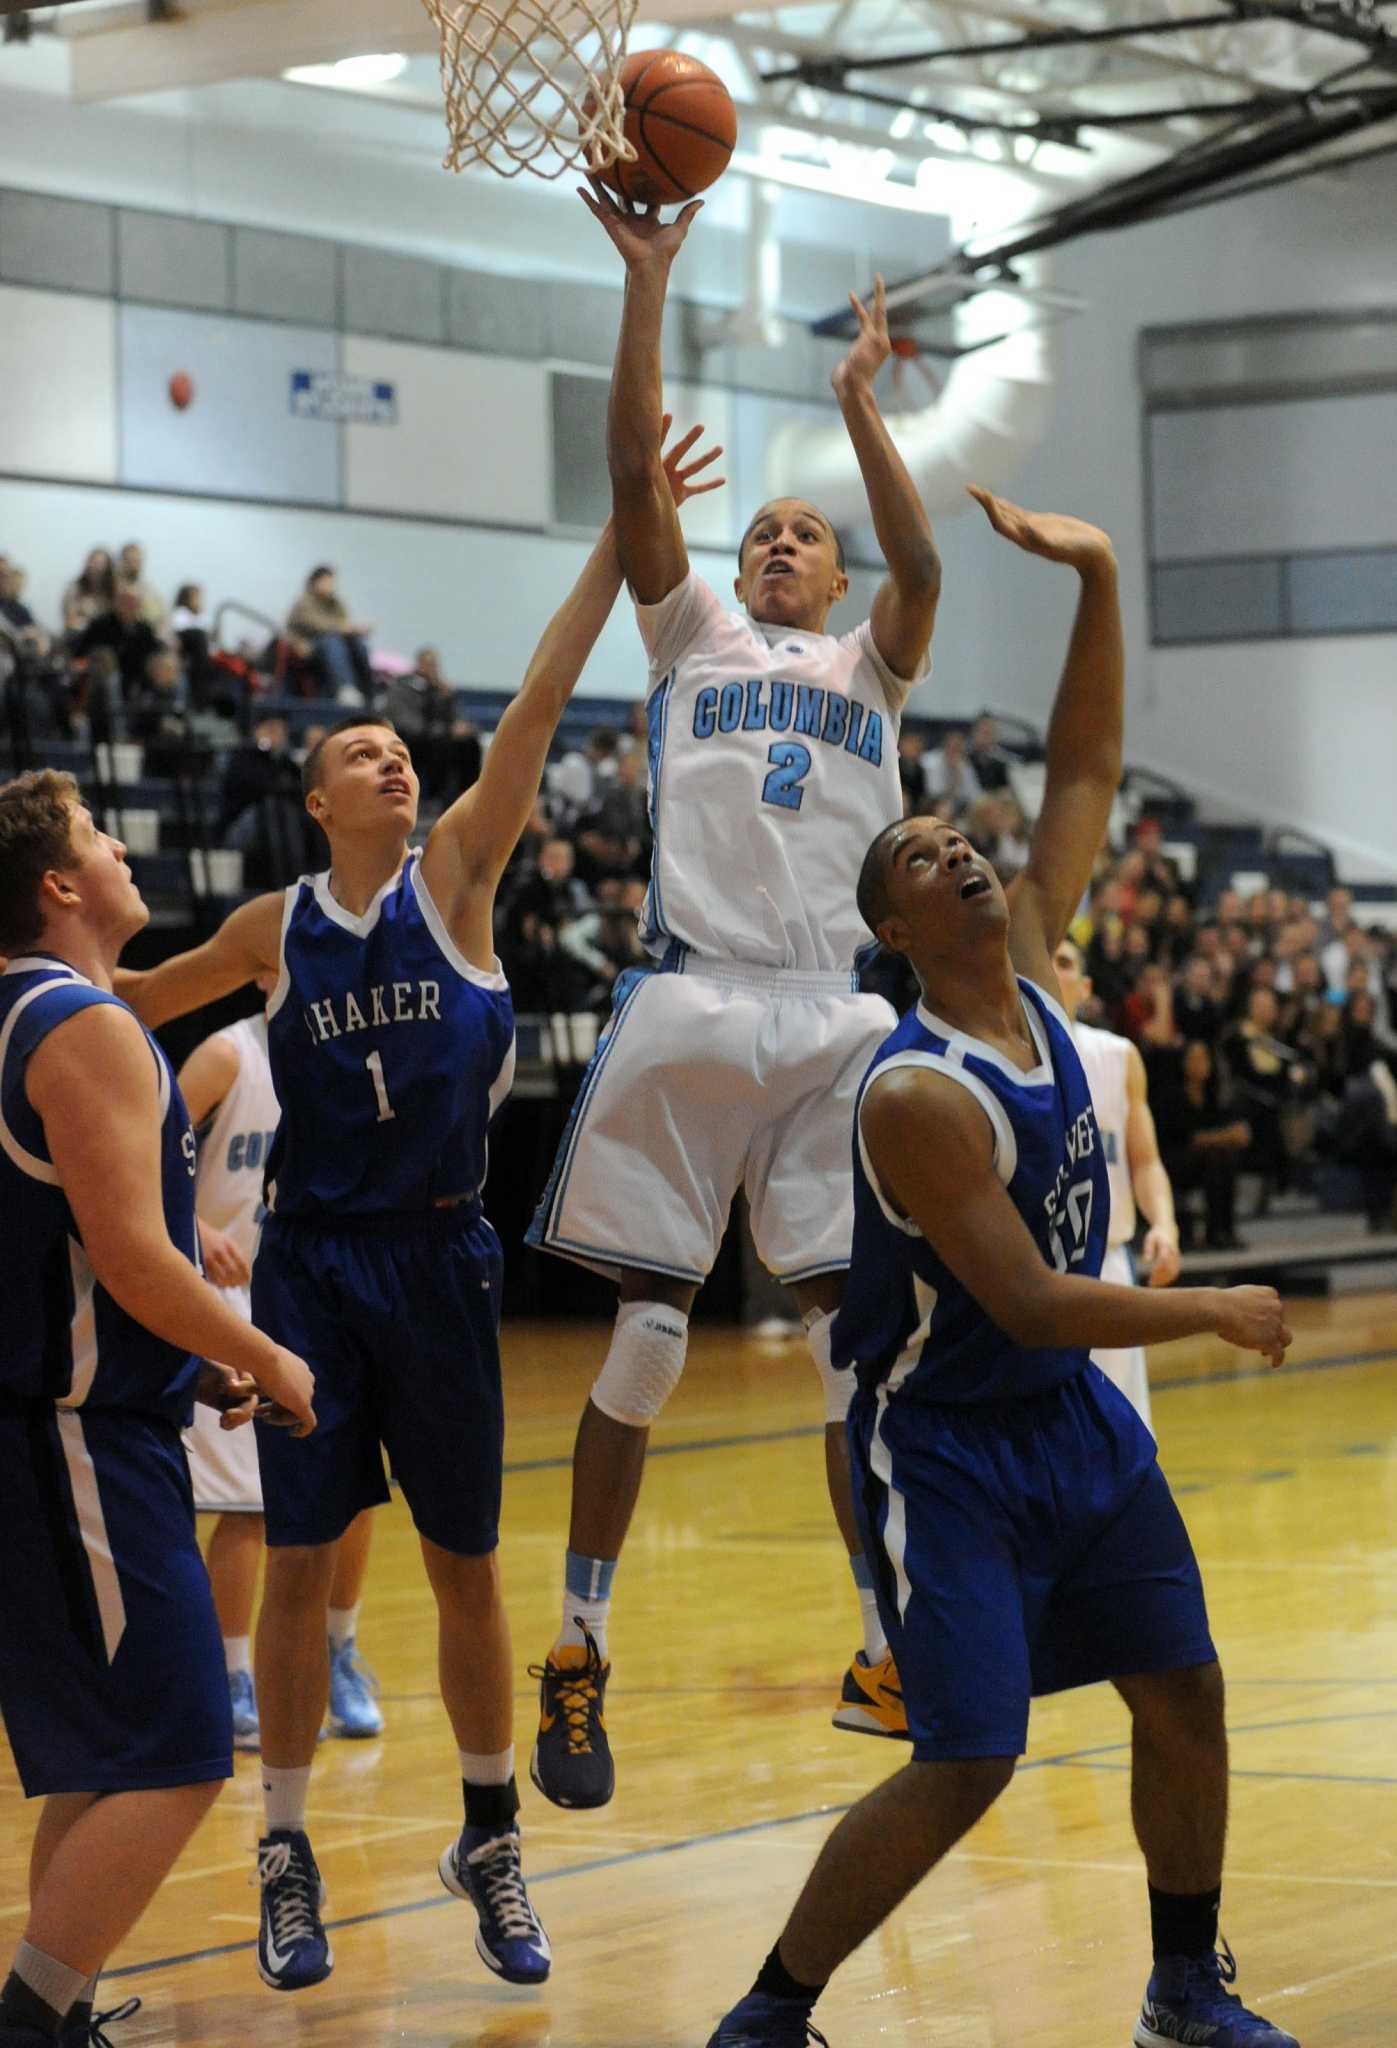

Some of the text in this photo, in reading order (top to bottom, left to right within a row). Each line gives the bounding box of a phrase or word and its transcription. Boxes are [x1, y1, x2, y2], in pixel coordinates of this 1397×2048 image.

[693, 680, 883, 768] COLUMBIA
[761, 741, 812, 811] 2
[304, 980, 441, 1046] HAKER
[366, 1050, 396, 1123] 1
